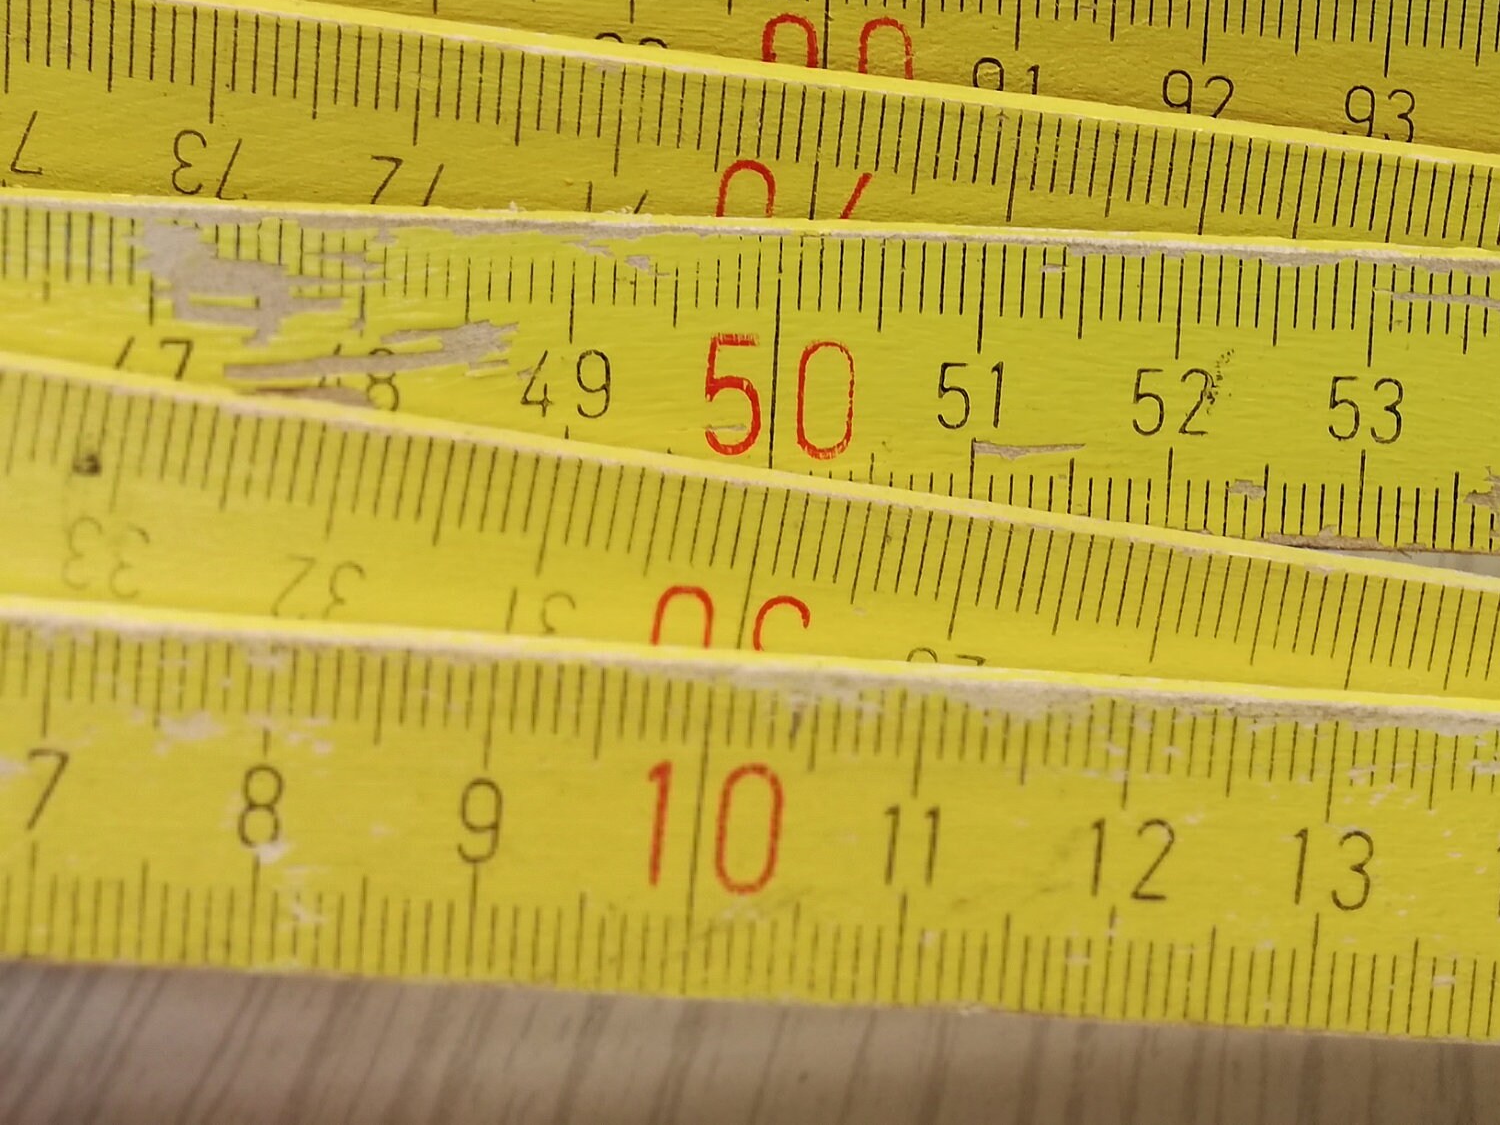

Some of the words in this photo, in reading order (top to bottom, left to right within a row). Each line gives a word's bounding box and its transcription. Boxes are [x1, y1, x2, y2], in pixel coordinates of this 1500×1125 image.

[1342, 85, 1416, 145] 93
[520, 349, 612, 419] 49
[705, 333, 854, 459] 50
[937, 361, 1004, 429] 51
[1131, 367, 1214, 436] 52
[1328, 376, 1404, 444] 53
[27, 747, 69, 830] 7
[237, 764, 285, 849] 8
[457, 777, 503, 864] 9
[647, 761, 784, 895] 10
[884, 804, 941, 888] 11
[1090, 817, 1177, 901] 12
[1293, 826, 1375, 912] 13
